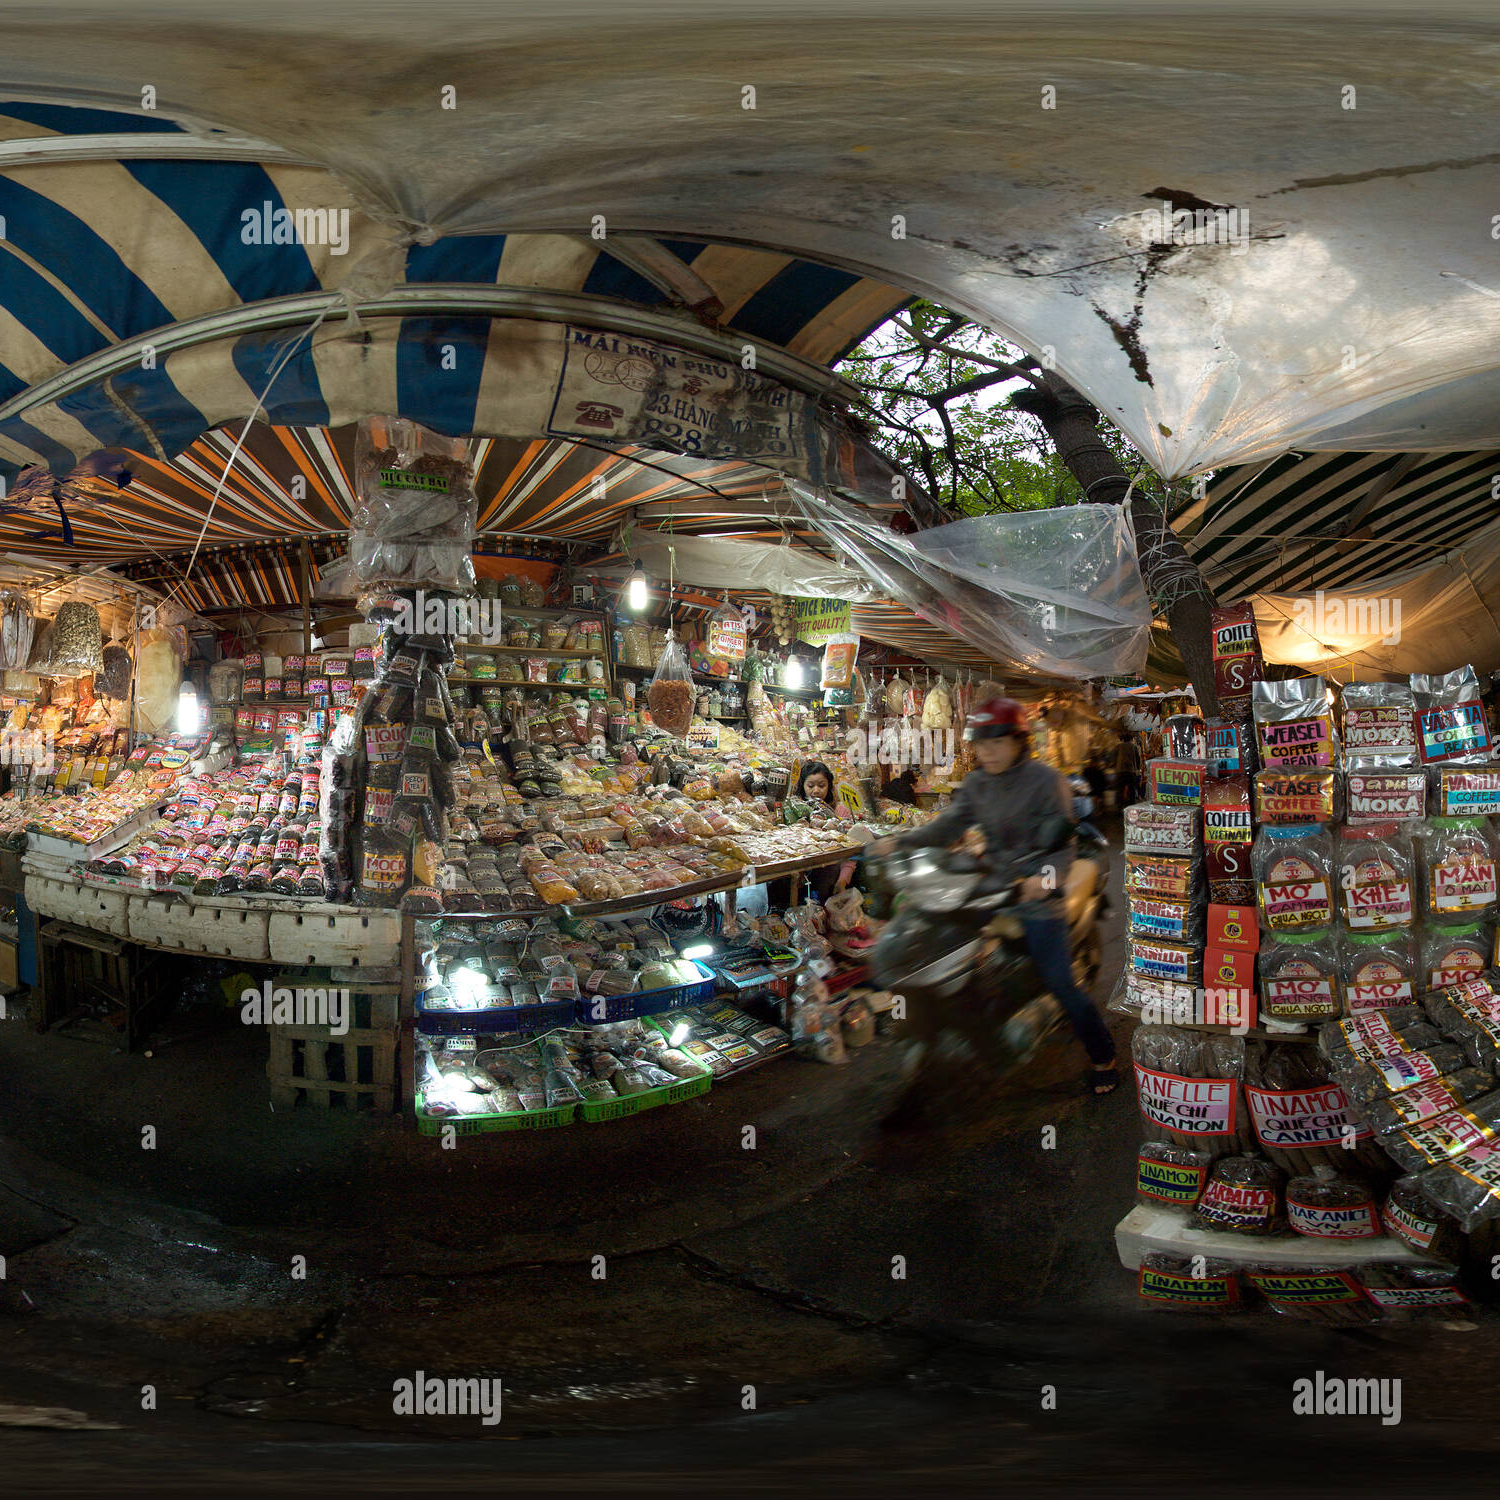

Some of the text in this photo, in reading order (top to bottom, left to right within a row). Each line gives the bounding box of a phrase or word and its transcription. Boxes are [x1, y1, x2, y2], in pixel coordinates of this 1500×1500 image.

[1261, 722, 1325, 746] WEASEL
[1348, 728, 1412, 743] MOKA
[1271, 742, 1319, 758] COFFEE
[1282, 754, 1318, 766] BEAN
[1158, 769, 1200, 785] LEMON
[1160, 795, 1198, 805] COFFEE
[1351, 796, 1421, 812] MOKA
[1456, 791, 1498, 802] COFFEE
[1127, 825, 1186, 844] MOKA
[1223, 847, 1238, 873] S
[1139, 1162, 1199, 1185] CINAMON
[1143, 1272, 1228, 1291] CINAMON
